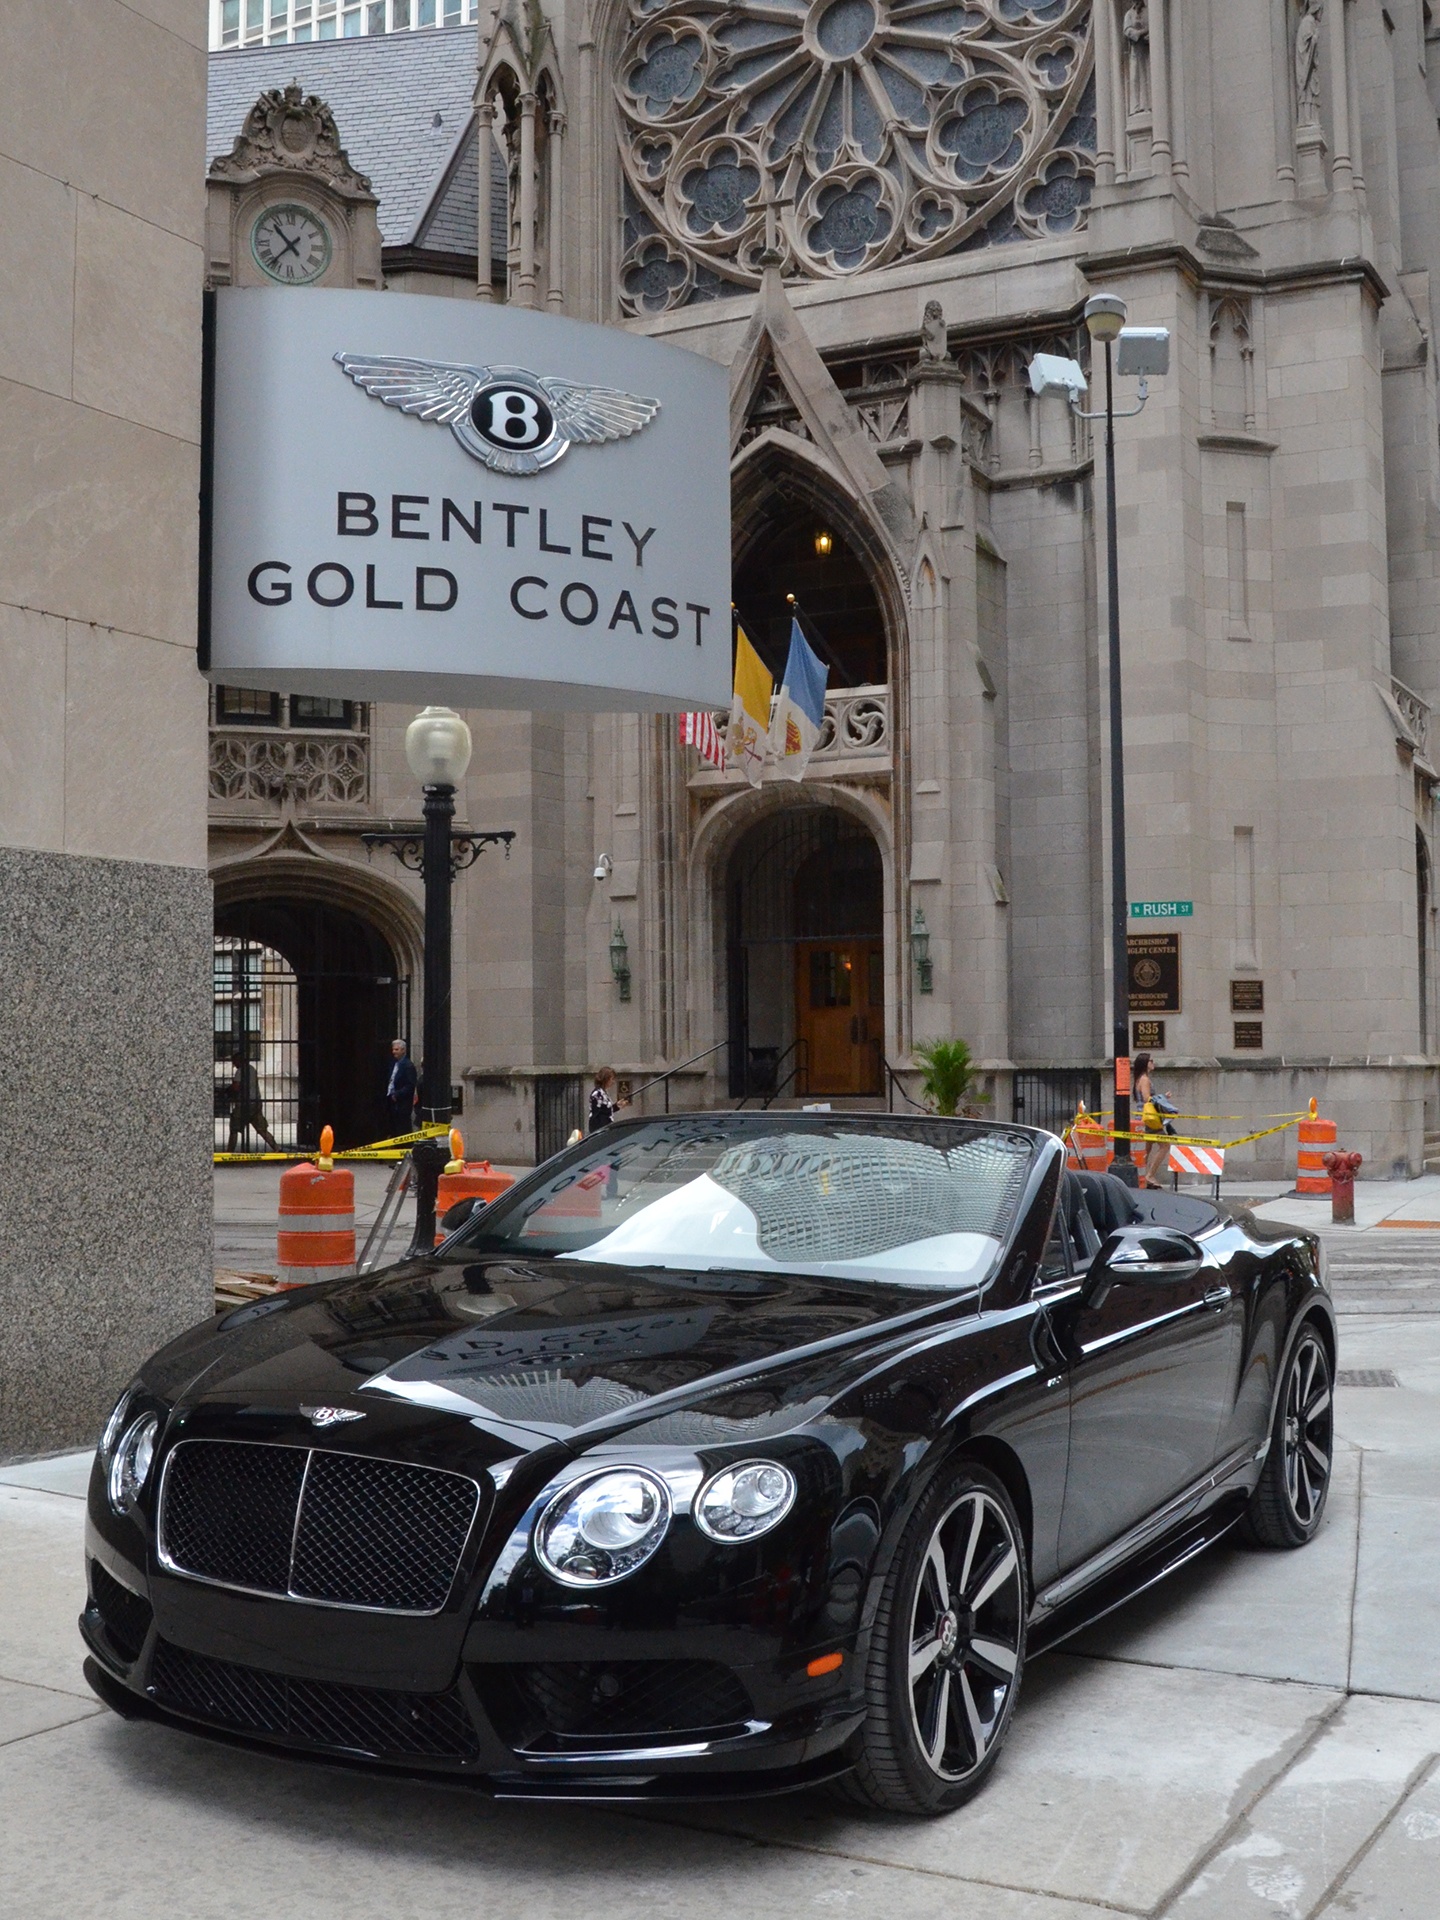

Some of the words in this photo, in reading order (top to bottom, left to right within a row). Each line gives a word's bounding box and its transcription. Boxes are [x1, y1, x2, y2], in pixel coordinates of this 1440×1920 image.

[490, 390, 540, 445] B
[336, 491, 657, 568] BENTLEY
[247, 560, 459, 612] GOLD
[509, 576, 711, 647] COAST
[1143, 903, 1177, 916] RUSH
[1181, 905, 1189, 913] ST
[1127, 947, 1147, 955] IGLEY
[1149, 946, 1177, 954] CENTER
[1138, 1022, 1159, 1034] 835
[393, 1131, 429, 1145] CAUTION
